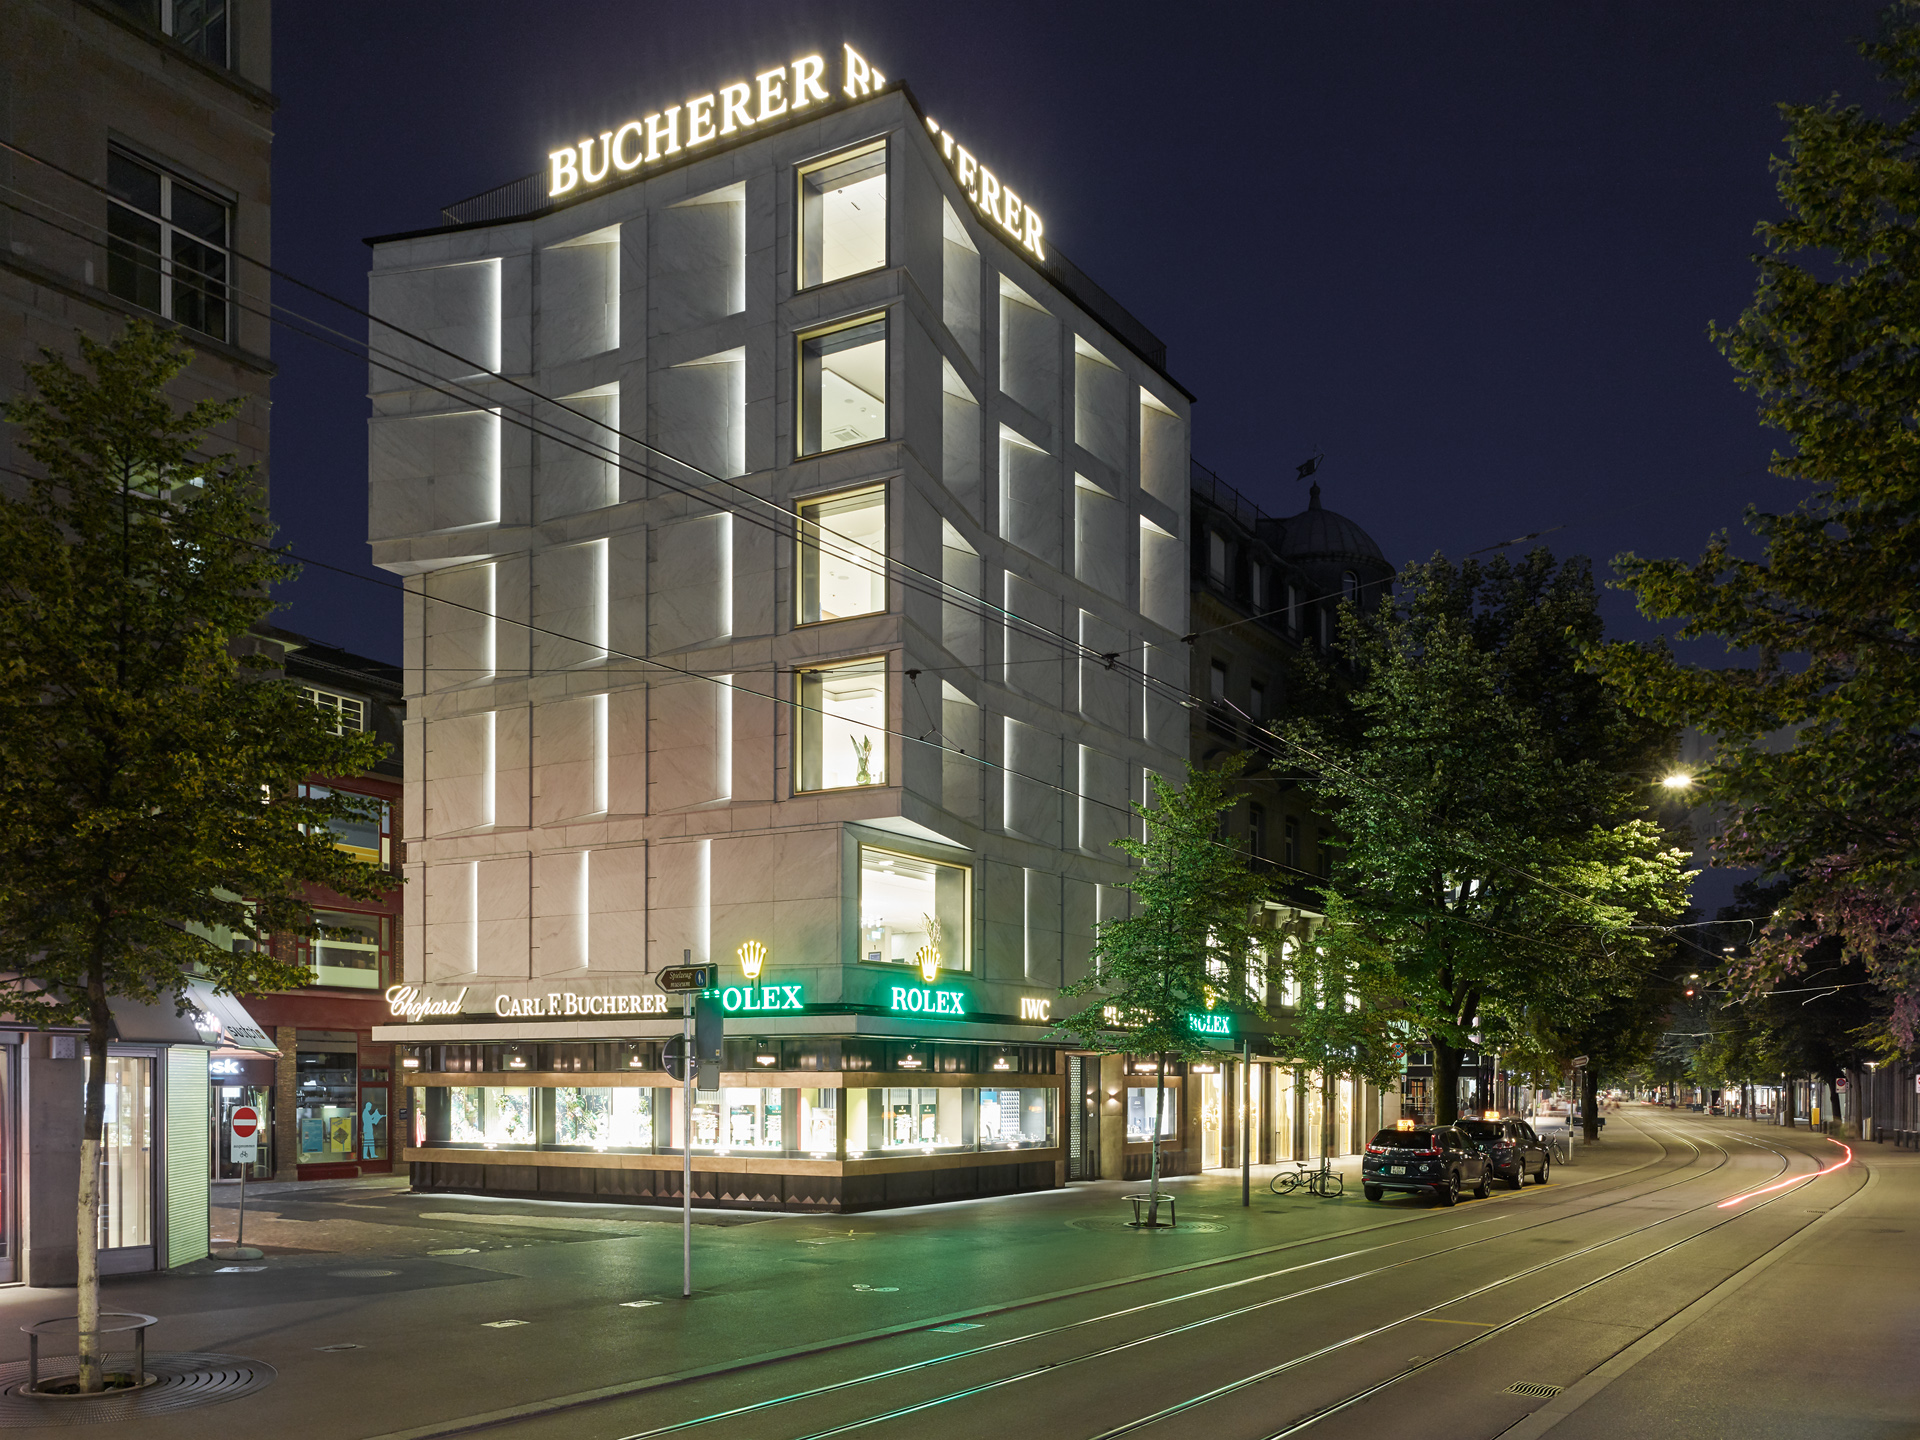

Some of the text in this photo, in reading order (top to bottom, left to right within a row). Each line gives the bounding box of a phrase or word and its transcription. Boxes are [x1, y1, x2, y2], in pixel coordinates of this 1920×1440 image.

[548, 54, 829, 197] BUCHERER
[385, 984, 468, 1022] Chopard
[495, 994, 545, 1017] CARL
[704, 985, 804, 1012] OLEX
[891, 986, 965, 1014] ROLEX
[1020, 997, 1050, 1021] IWC
